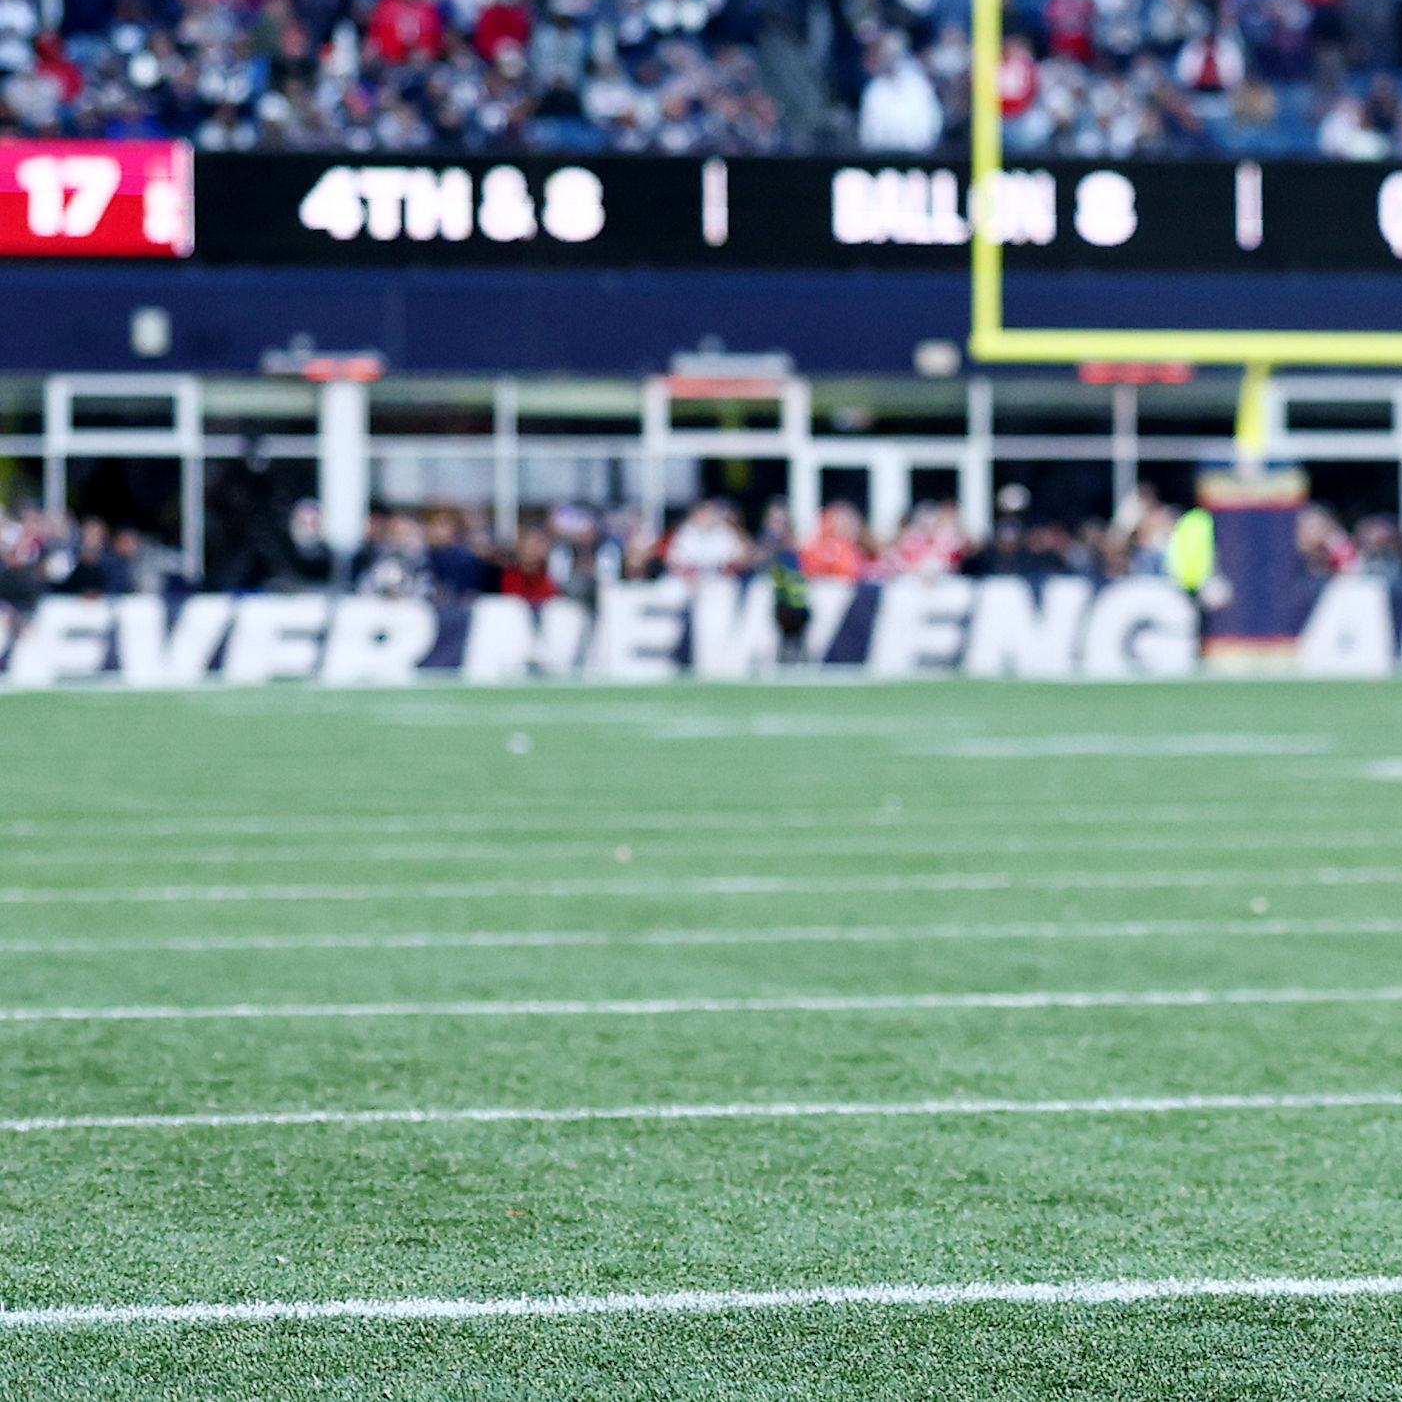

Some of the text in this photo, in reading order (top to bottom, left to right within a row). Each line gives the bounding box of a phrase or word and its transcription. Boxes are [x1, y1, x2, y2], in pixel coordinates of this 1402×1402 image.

[15, 154, 122, 238] 17
[300, 165, 473, 241] 4TH
[542, 166, 605, 243] 8
[1074, 170, 1138, 246] 8
